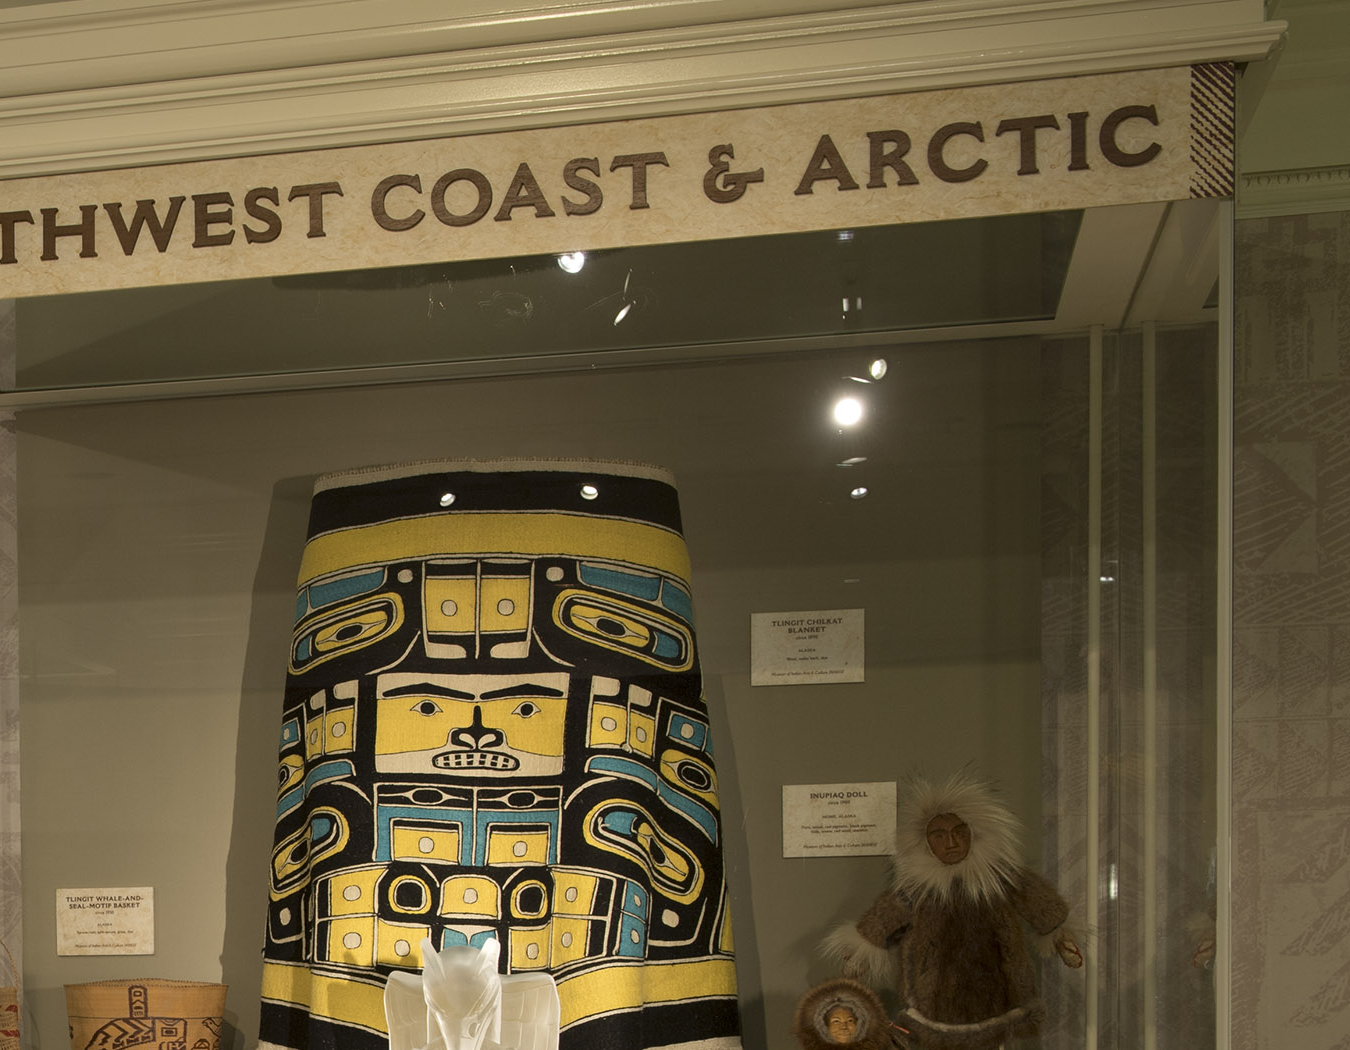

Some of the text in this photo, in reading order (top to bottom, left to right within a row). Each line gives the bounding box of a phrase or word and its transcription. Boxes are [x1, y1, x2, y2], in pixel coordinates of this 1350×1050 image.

[370, 152, 670, 232] COAST
[703, 143, 765, 203] &
[794, 104, 1163, 196] ARCTIC
[771, 618, 843, 627] TLINGIT CHILKAT
[788, 626, 826, 634] BLANKET
